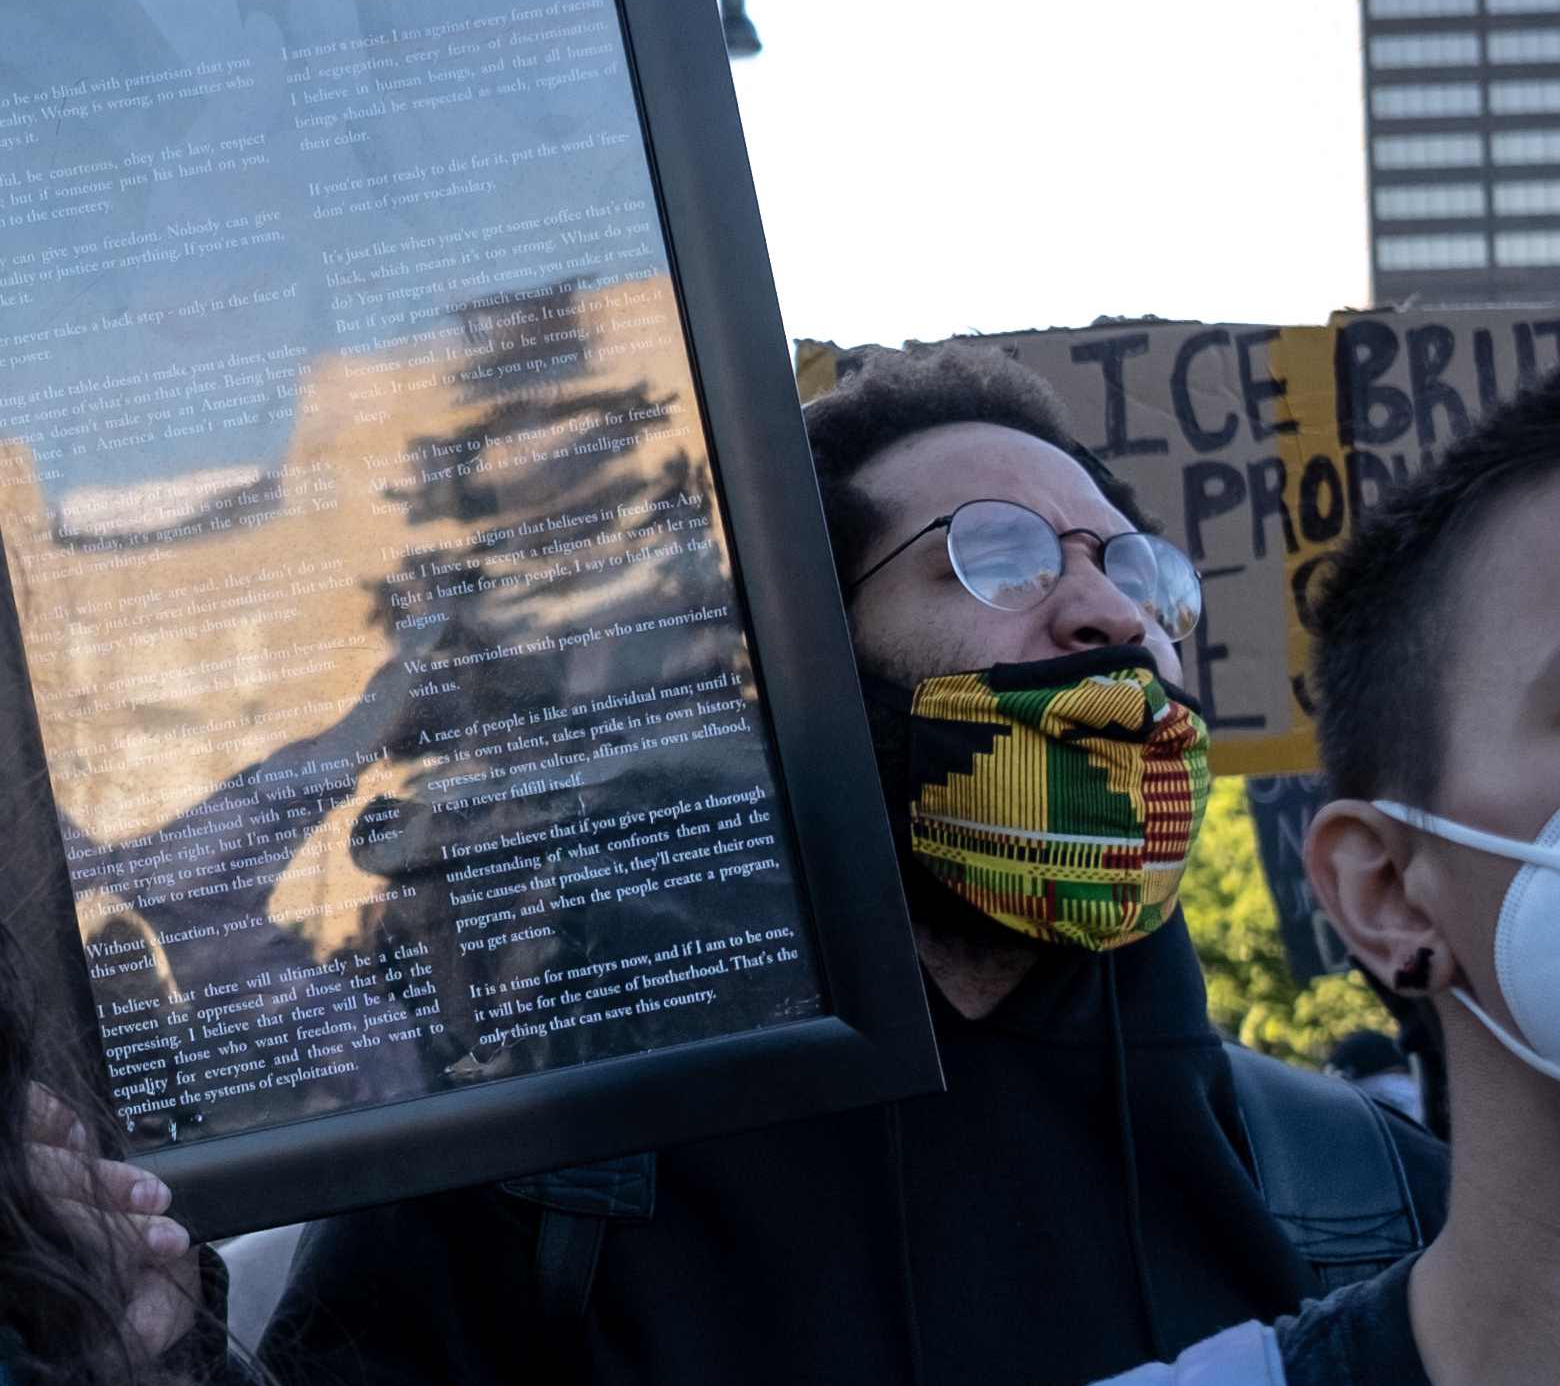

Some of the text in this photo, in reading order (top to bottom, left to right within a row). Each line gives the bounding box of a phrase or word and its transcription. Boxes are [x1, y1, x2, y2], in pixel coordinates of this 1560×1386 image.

[404, 606, 727, 674] We are nonviolent with people who are nonviolent
[408, 681, 439, 698] with
[441, 788, 765, 860] I for one believe that if you give people a thorough
[446, 812, 769, 882] understanding of what confronts them and the
[449, 889, 483, 905] basic
[486, 884, 527, 898] causes
[529, 876, 556, 890] that
[559, 867, 611, 889] produce
[630, 852, 670, 871] they'll
[671, 847, 711, 862] create
[713, 840, 744, 854] their
[746, 836, 774, 848] own
[520, 899, 545, 916] and
[549, 895, 585, 909] when
[590, 888, 611, 902] the
[616, 878, 658, 902] people
[663, 872, 702, 888] create
[707, 870, 715, 880] a
[460, 939, 484, 956] you
[487, 933, 507, 951] get
[469, 985, 481, 998] It
[484, 983, 496, 995] is
[499, 983, 507, 992] a
[510, 976, 540, 990] time
[544, 971, 563, 984] for
[567, 961, 617, 979] martyrs
[654, 946, 679, 961] and
[682, 944, 691, 956] if
[696, 942, 702, 954] I
[705, 941, 726, 952] am
[729, 936, 743, 947] to
[745, 932, 762, 943] be
[474, 1009, 485, 1022] it
[488, 1002, 513, 1018] will
[515, 1000, 532, 1013] be
[536, 996, 556, 1009] for
[560, 991, 581, 1004] the
[585, 984, 620, 999] cause
[625, 977, 638, 991] of
[734, 952, 773, 970] That's
[776, 948, 798, 961] the
[108, 1058, 166, 1077] between
[174, 1049, 210, 1065] those
[217, 1041, 247, 1055] who
[254, 1033, 288, 1047] want
[363, 1010, 407, 1031] justice
[415, 1001, 440, 1017] and
[479, 1027, 509, 1045] only
[510, 1023, 547, 1038] thing
[549, 1016, 576, 1030] that
[579, 1012, 602, 1024] can
[605, 1006, 633, 1019] save
[635, 999, 660, 1013] this
[113, 1023, 444, 1099] equality for everyone and those who want to
[117, 1098, 176, 1117] continue
[179, 1090, 201, 1105] the
[204, 1082, 256, 1103] systems
[258, 1074, 272, 1088] of
